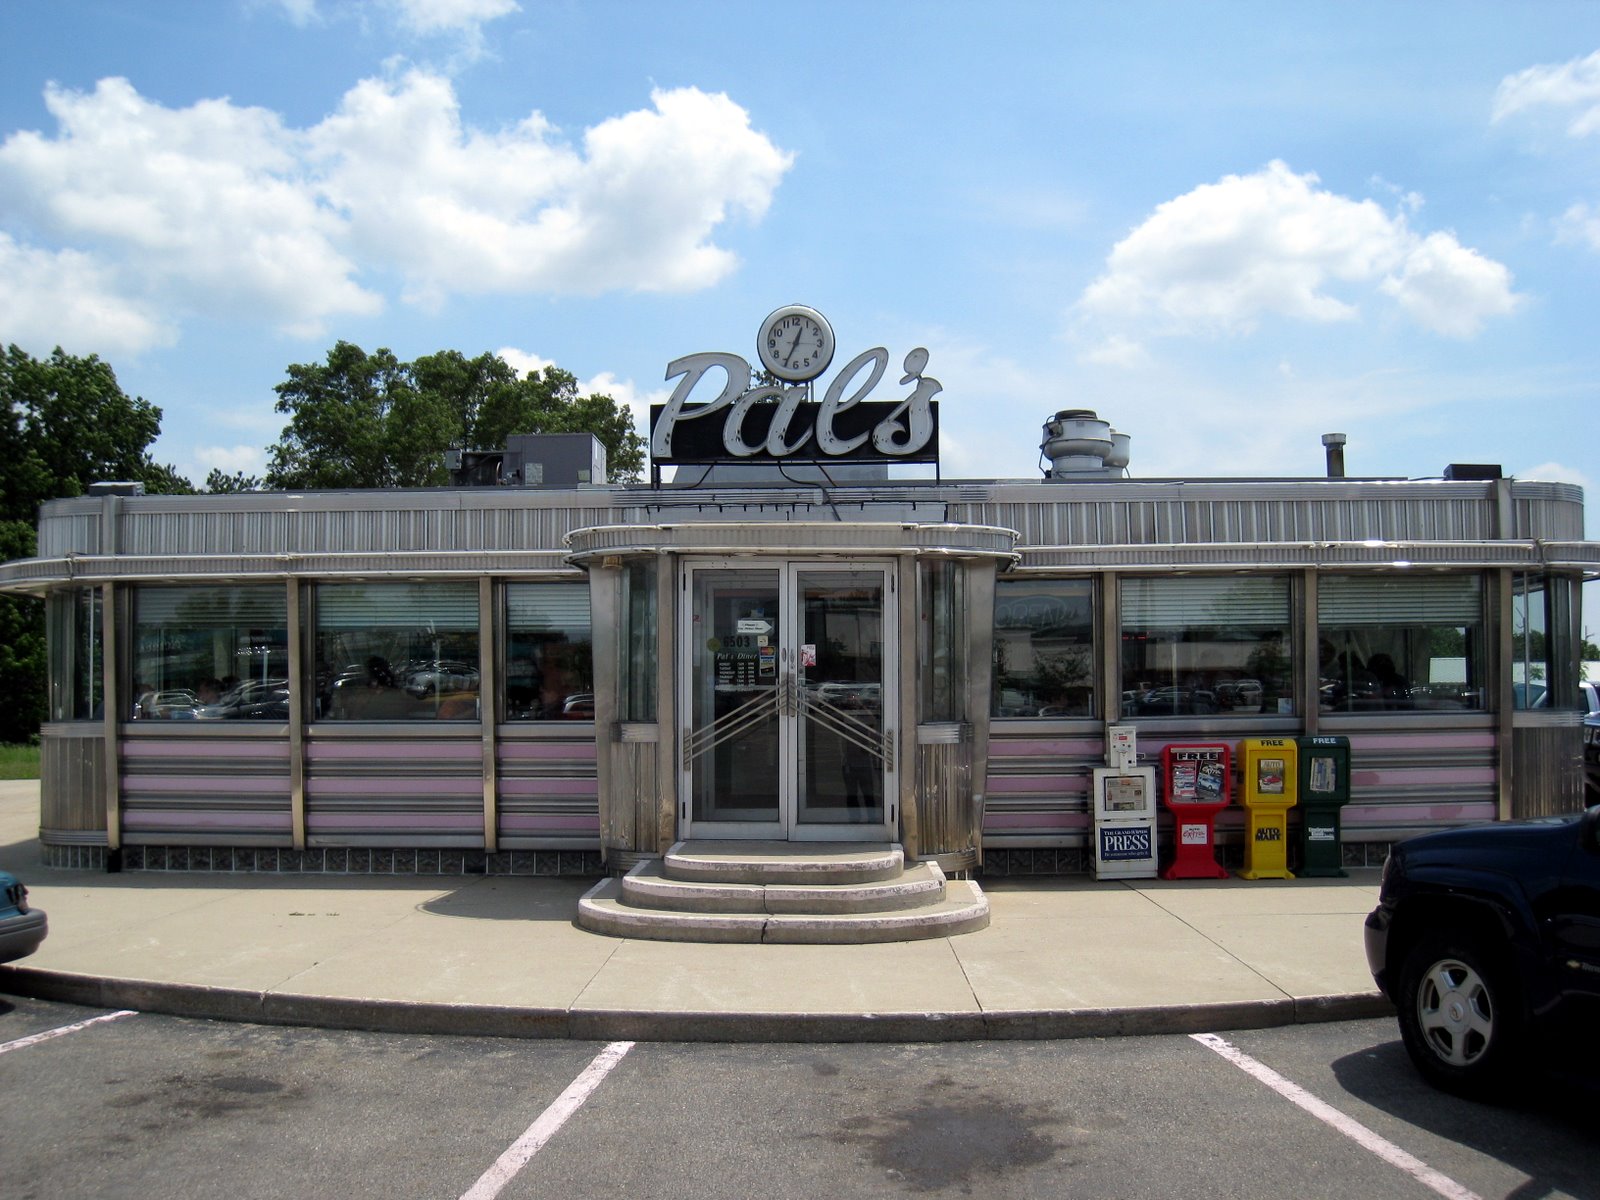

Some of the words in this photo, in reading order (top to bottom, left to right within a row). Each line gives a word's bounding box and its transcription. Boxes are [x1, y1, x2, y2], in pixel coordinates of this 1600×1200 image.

[783, 320, 790, 328] 11
[792, 317, 801, 326] 12
[774, 329, 783, 337] 10
[812, 328, 819, 336] 2
[769, 339, 776, 348] 9
[816, 339, 823, 348] 3
[773, 350, 779, 358] 8
[812, 350, 818, 358] 4
[792, 361, 800, 370] 6
[803, 358, 810, 367] 5
[652, 347, 943, 457] Pal's
[723, 635, 751, 648] 6503
[736, 652, 757, 660] Diner
[1177, 752, 1217, 760] FREE
[1104, 834, 1149, 851] PRESS
